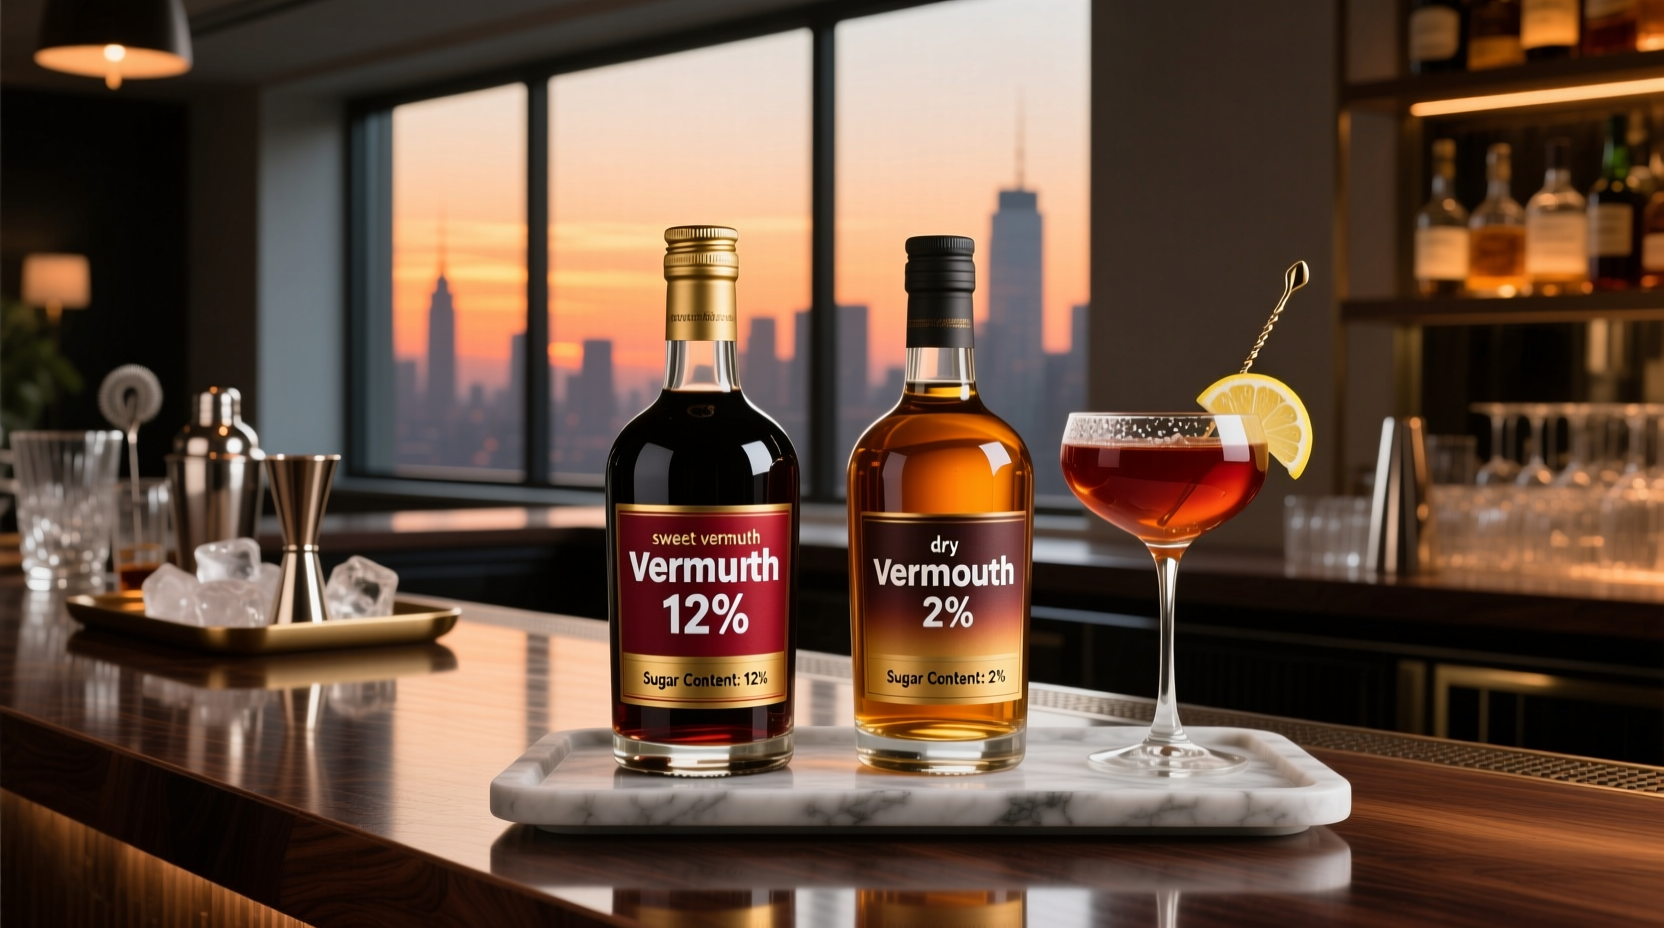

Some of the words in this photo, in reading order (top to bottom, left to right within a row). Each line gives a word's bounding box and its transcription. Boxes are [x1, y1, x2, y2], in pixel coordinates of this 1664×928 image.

[652, 531, 696, 546] sweet
[930, 534, 959, 557] dry
[629, 547, 779, 583] Vermurth
[873, 555, 1015, 588] Vermouth
[662, 593, 749, 635] 12%
[922, 595, 974, 628] 2%
[643, 671, 680, 690] Sugar
[683, 672, 741, 687] Content:
[744, 671, 768, 686] 12%
[886, 669, 924, 688] Sugar
[927, 671, 985, 686] Content:
[988, 669, 1006, 684] 2%
